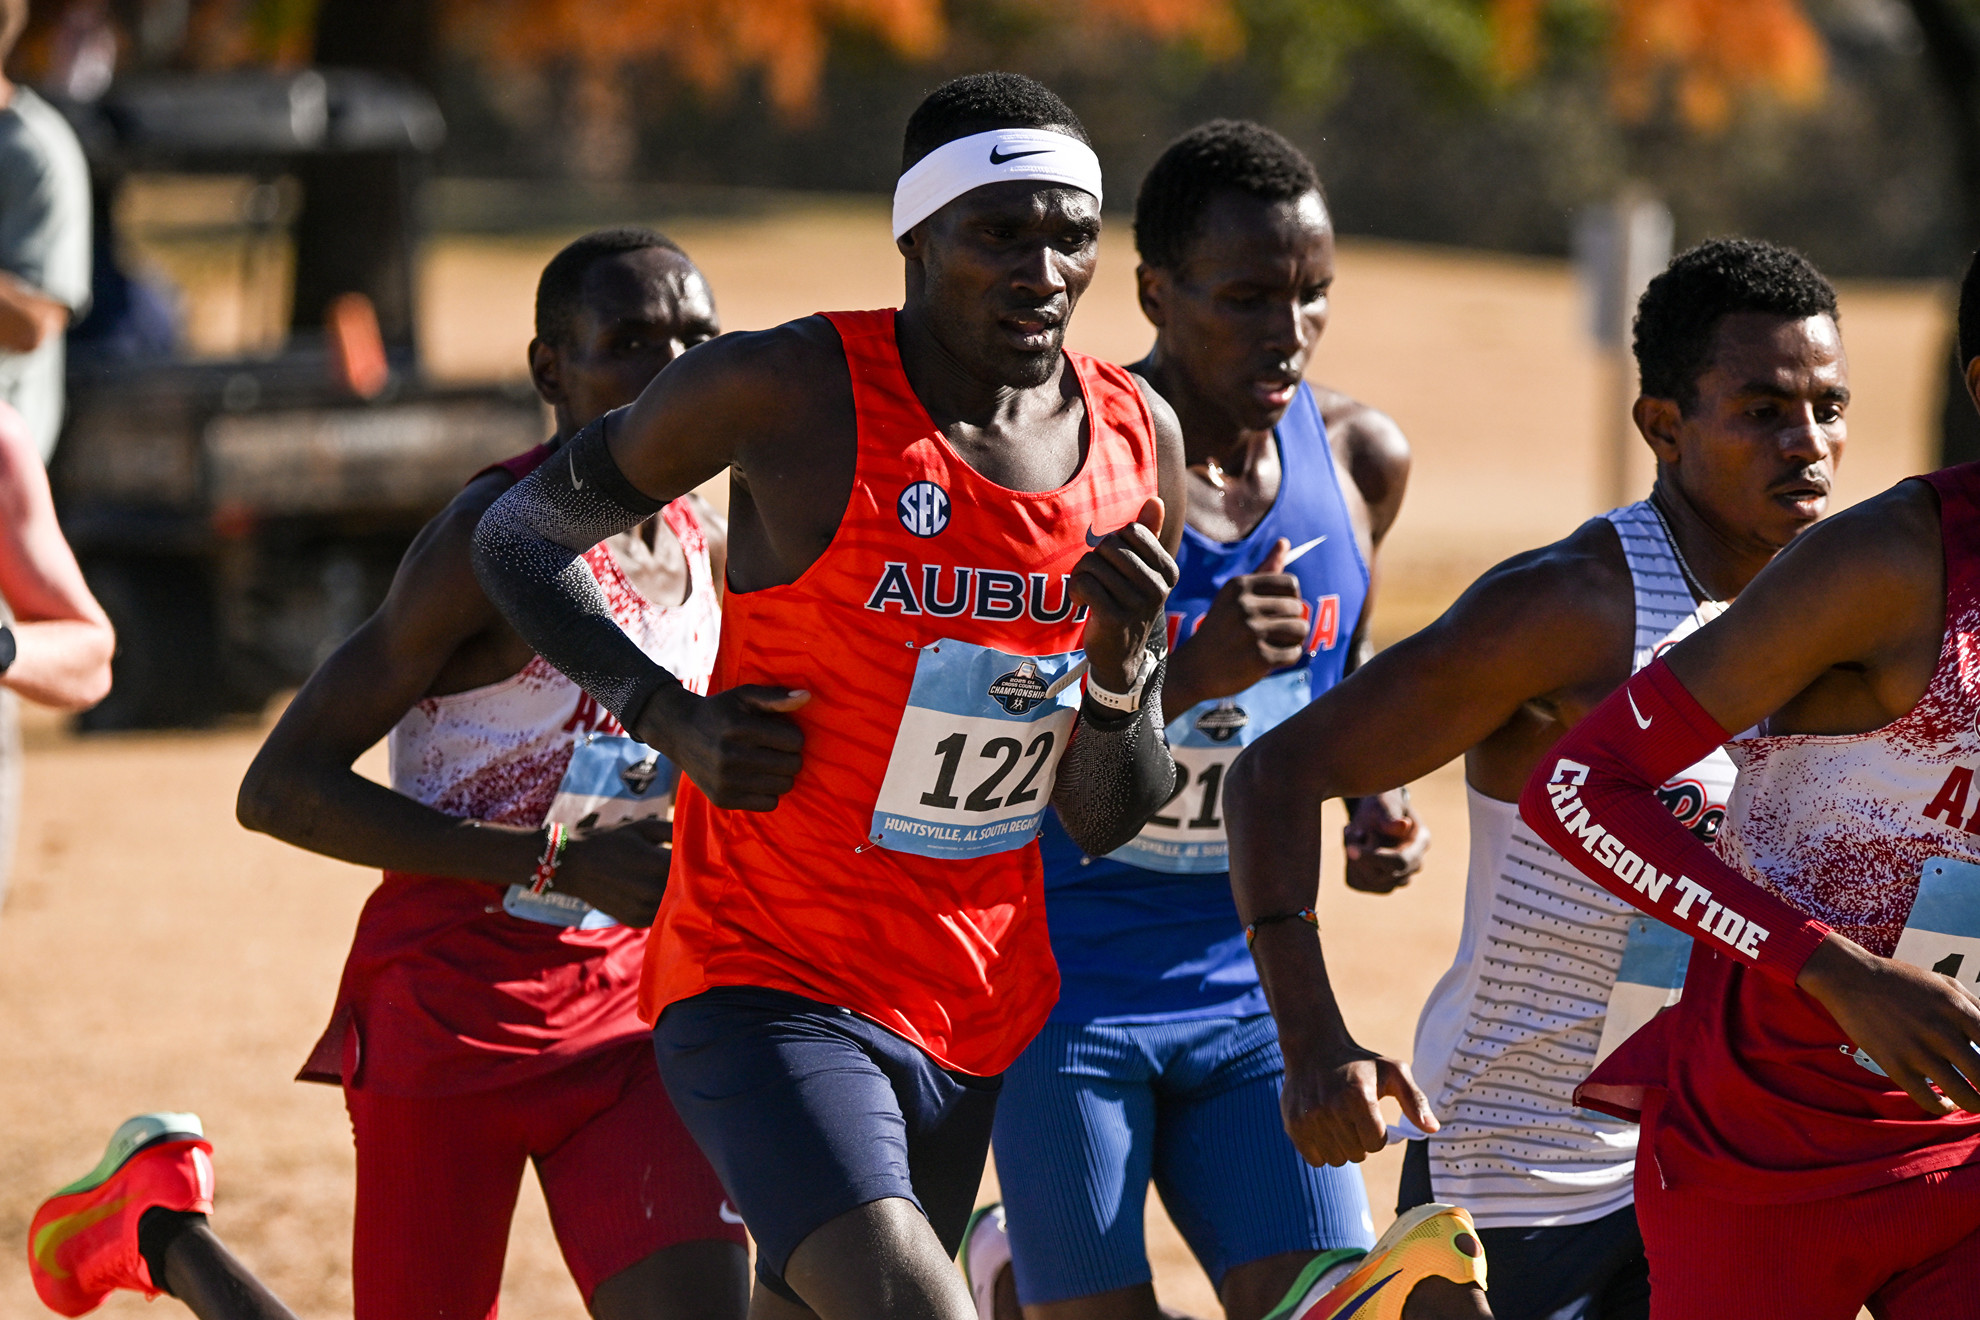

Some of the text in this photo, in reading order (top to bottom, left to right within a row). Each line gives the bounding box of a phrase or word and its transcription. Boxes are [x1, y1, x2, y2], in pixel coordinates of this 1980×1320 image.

[900, 483, 948, 535] SEC
[864, 561, 1089, 624] AUBU
[919, 731, 1055, 812] 122
[884, 817, 961, 842] HUNTSVILLE,
[963, 830, 977, 842] AL
[979, 823, 1008, 839] SOUTH
[1547, 758, 1770, 960] CRIMSON TIDE
